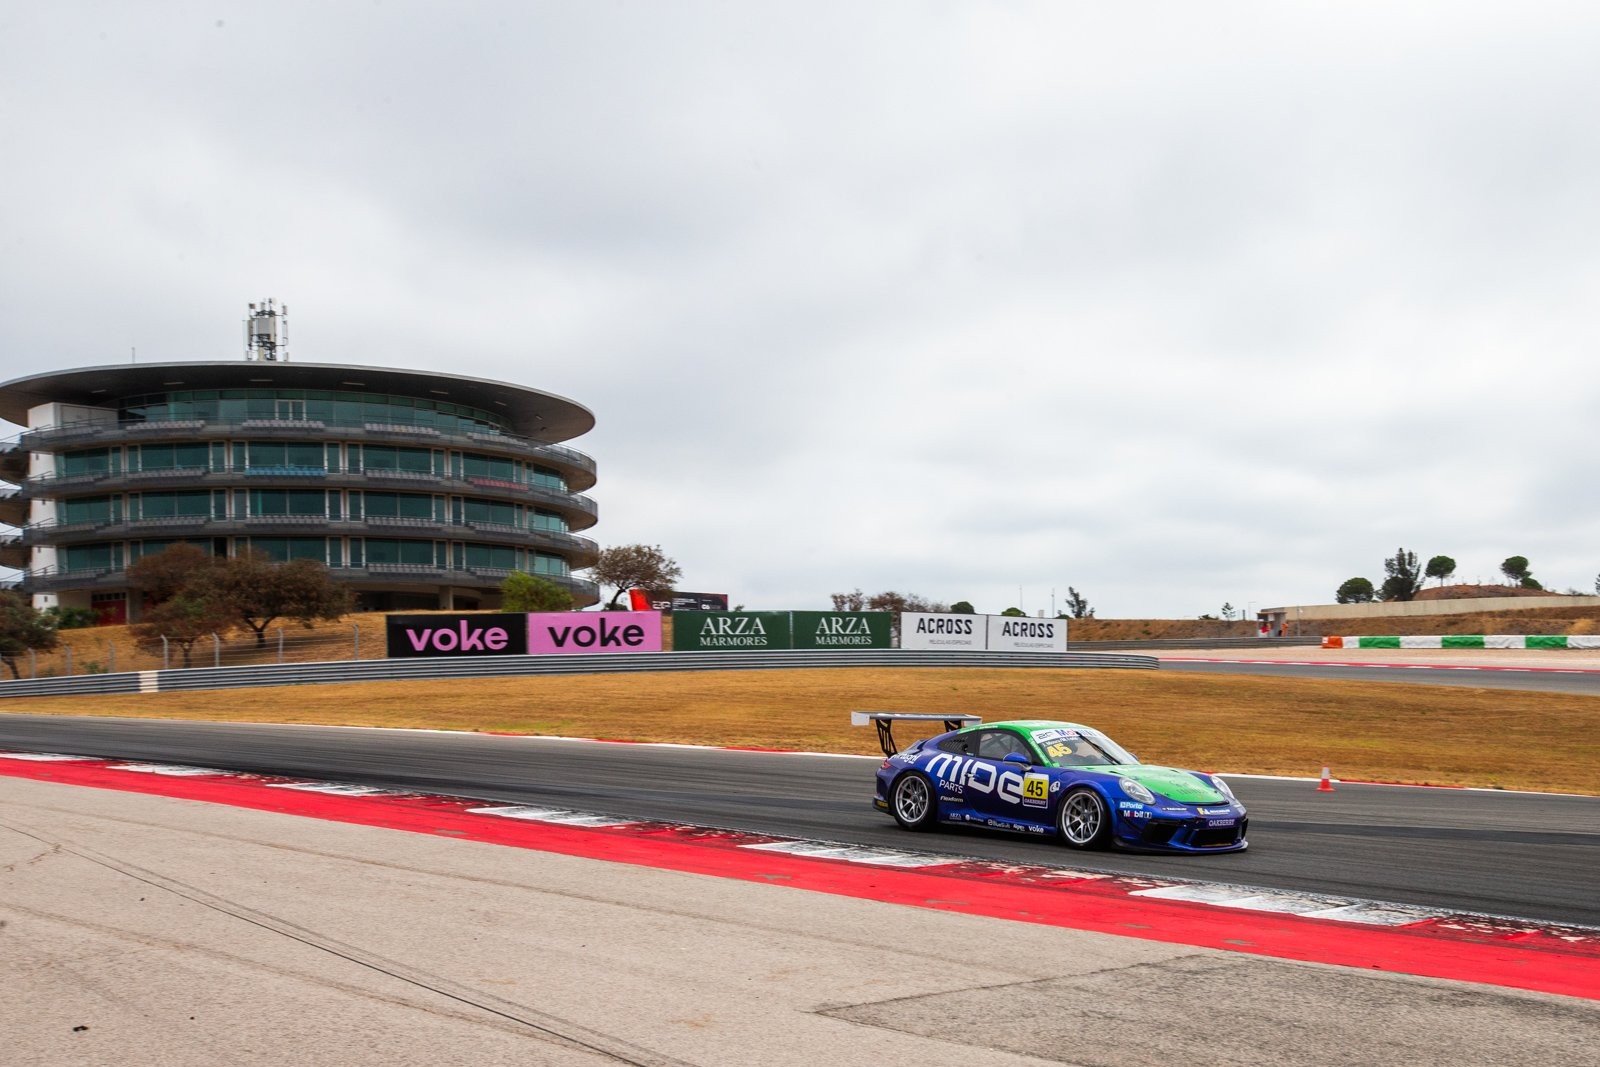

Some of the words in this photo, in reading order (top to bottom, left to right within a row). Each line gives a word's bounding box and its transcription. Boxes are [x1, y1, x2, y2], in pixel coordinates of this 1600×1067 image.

[406, 619, 509, 651] voke
[547, 617, 644, 648] voke
[700, 617, 767, 635] ARZA
[815, 617, 871, 635] ARZA
[916, 617, 973, 635] ACROSS
[1002, 621, 1054, 639] ACROSS
[1046, 743, 1072, 758] 45
[939, 779, 964, 794] PARTS
[1026, 780, 1043, 797] 45
[1028, 824, 1044, 834] voke
